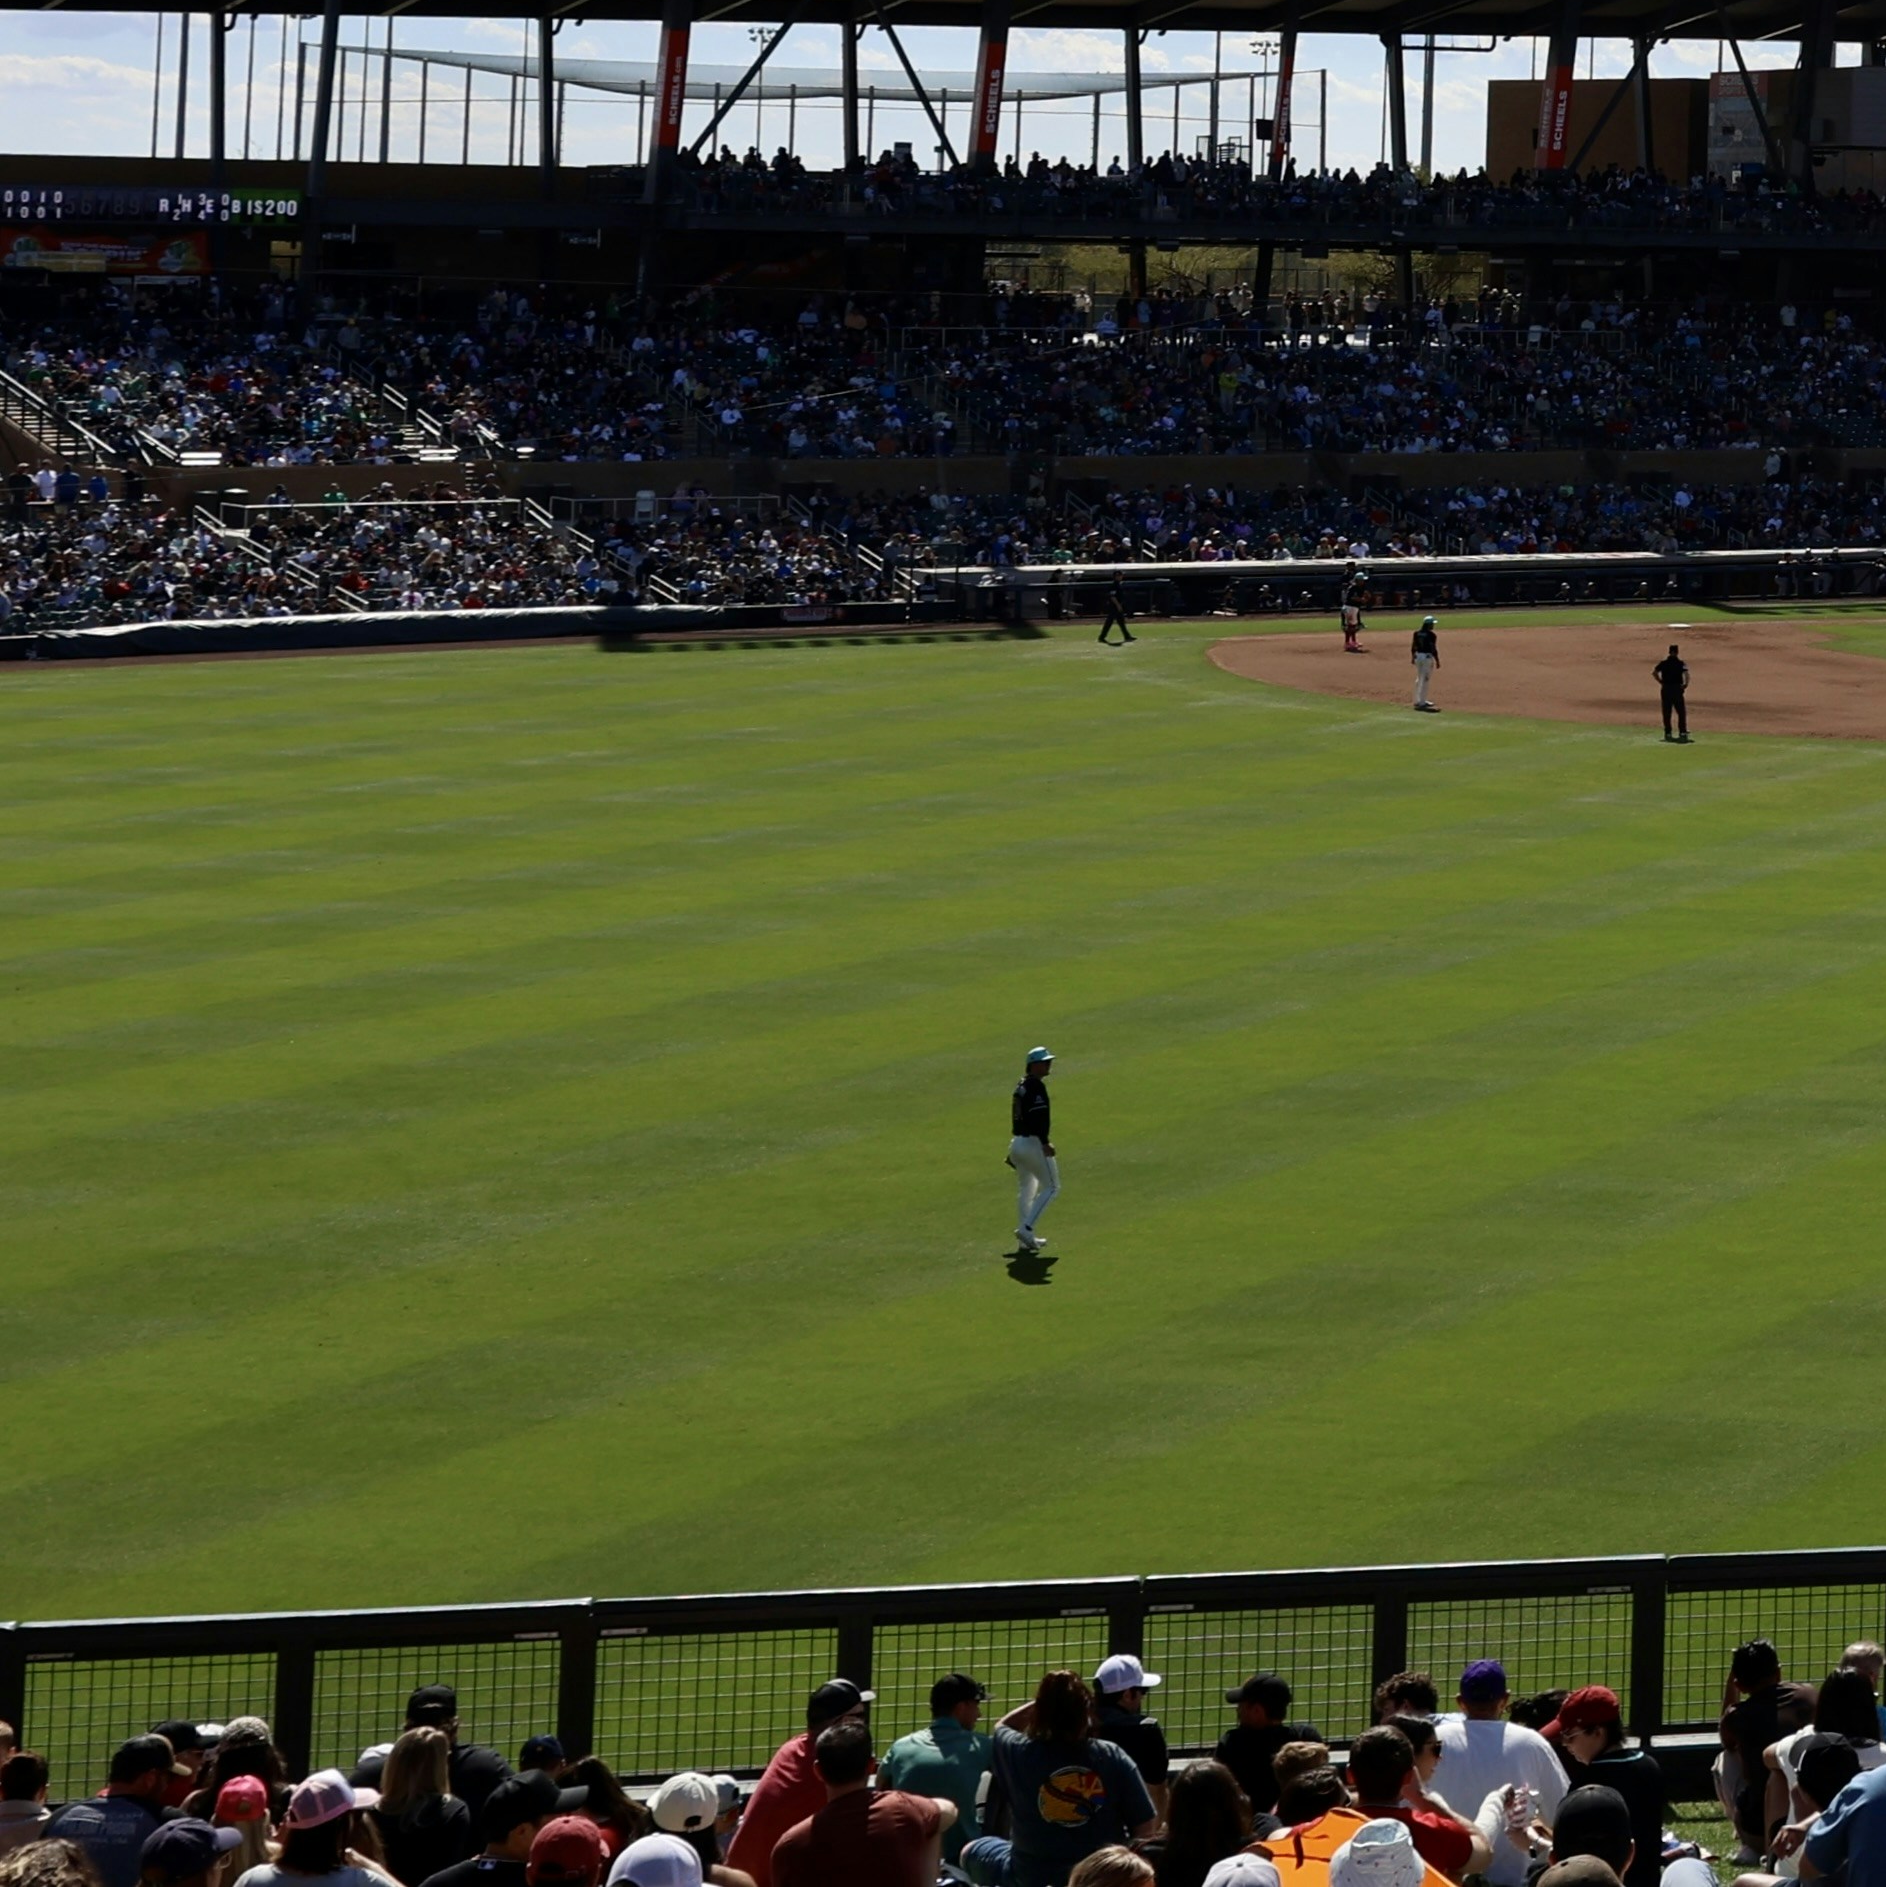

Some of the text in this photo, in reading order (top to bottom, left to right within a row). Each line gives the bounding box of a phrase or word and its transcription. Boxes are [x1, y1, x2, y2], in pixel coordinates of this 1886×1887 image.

[985, 69, 1000, 134] SCHEELS
[1553, 90, 1568, 151] SCHEELS
[4, 190, 13, 203] 0
[20, 190, 30, 203] 0
[53, 191, 63, 203] 0
[20, 206, 30, 219] 0
[36, 206, 46, 219] 0
